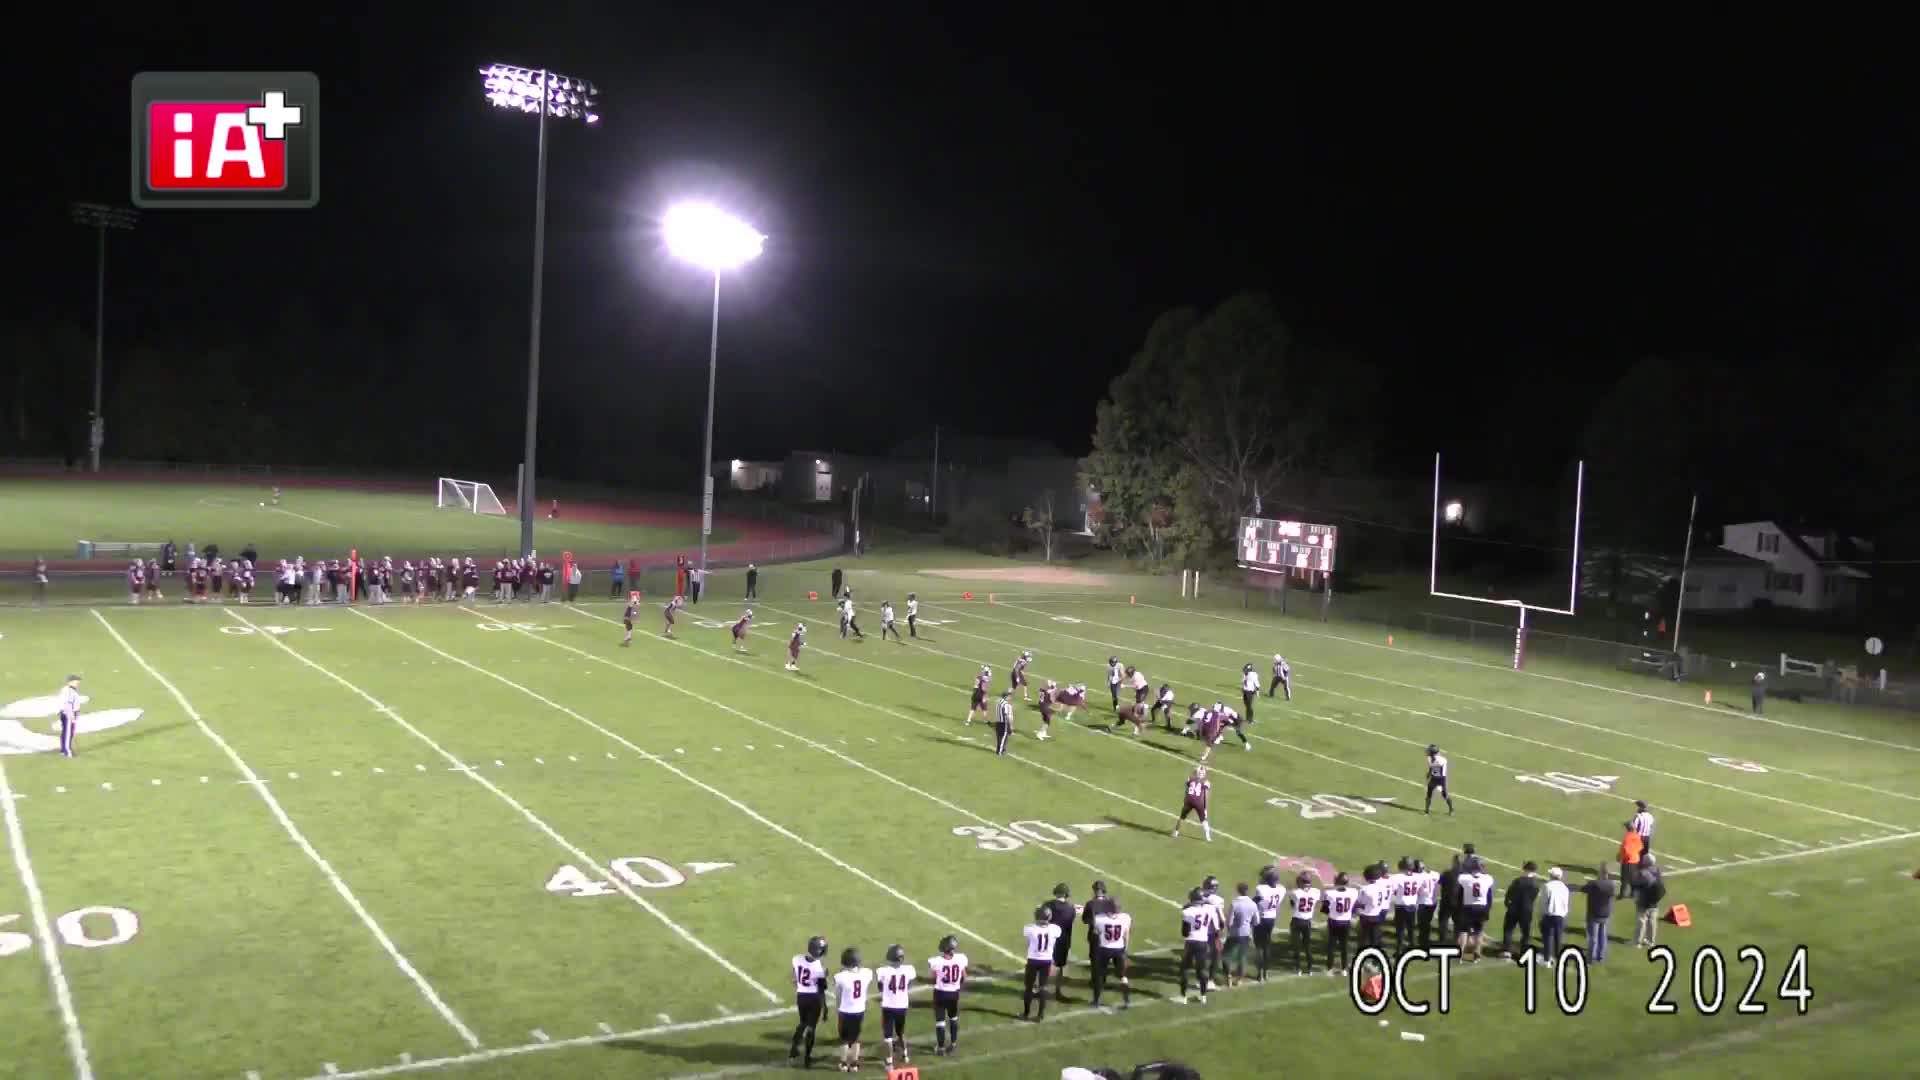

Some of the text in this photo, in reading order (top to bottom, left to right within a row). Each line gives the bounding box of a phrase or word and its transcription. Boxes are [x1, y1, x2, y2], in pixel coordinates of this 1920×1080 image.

[952, 820, 1079, 851] 30
[545, 857, 687, 897] 40
[1298, 897, 1314, 912] 25
[1037, 933, 1049, 951] 11
[797, 965, 811, 987] 12
[888, 974, 906, 994] 44
[942, 964, 959, 984] 30
[853, 980, 861, 999] 8
